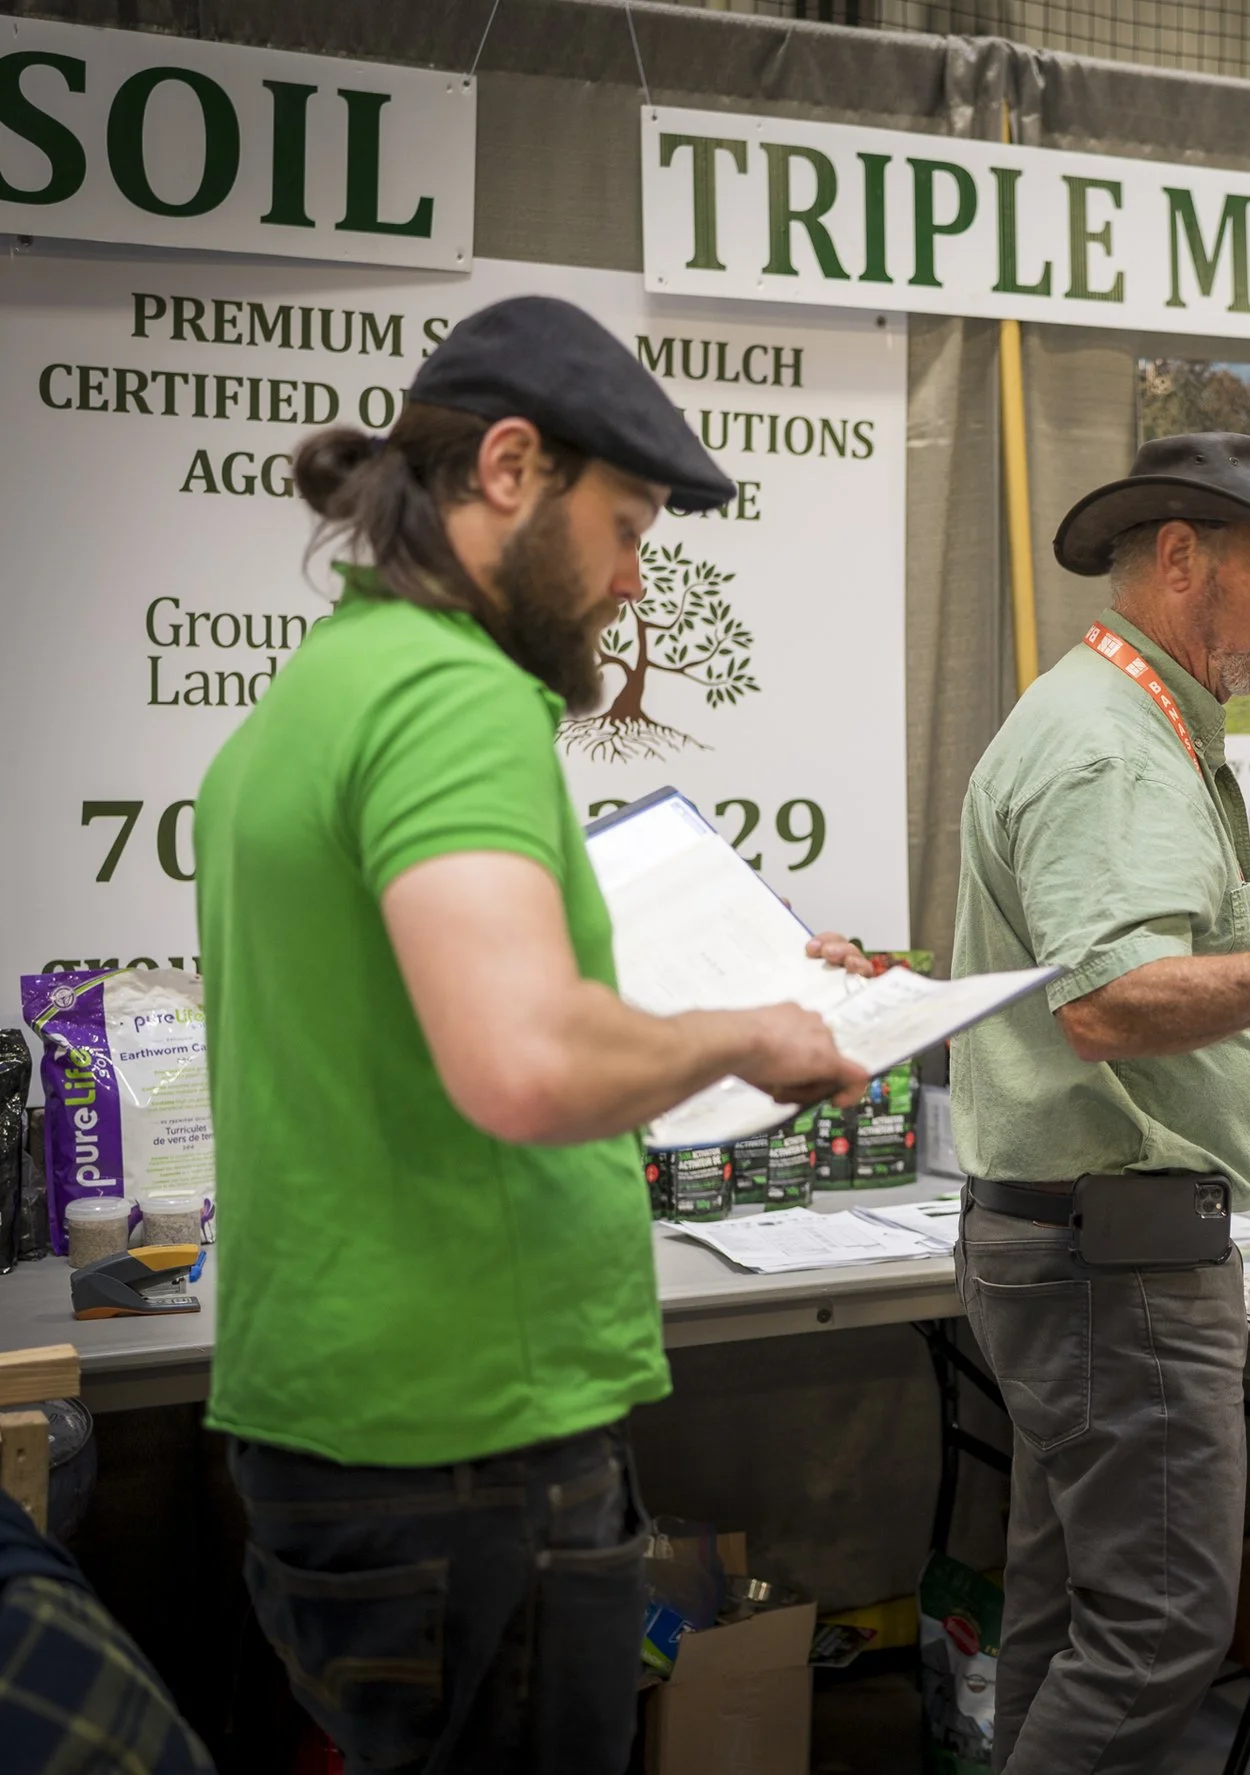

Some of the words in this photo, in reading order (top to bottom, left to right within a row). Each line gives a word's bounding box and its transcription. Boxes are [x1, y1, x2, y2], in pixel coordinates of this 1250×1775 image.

[0, 51, 435, 239] SOIL
[659, 132, 1124, 303] TRIPLE
[131, 292, 405, 358] PREMIUM
[635, 334, 804, 388] MULCH
[38, 362, 340, 425] CERTIFIED
[680, 406, 875, 460] UTIONS
[145, 596, 340, 649] Groun
[147, 655, 278, 707] Land
[119, 1045, 189, 1062] Earthworm
[64, 1047, 117, 1188] pureLife
